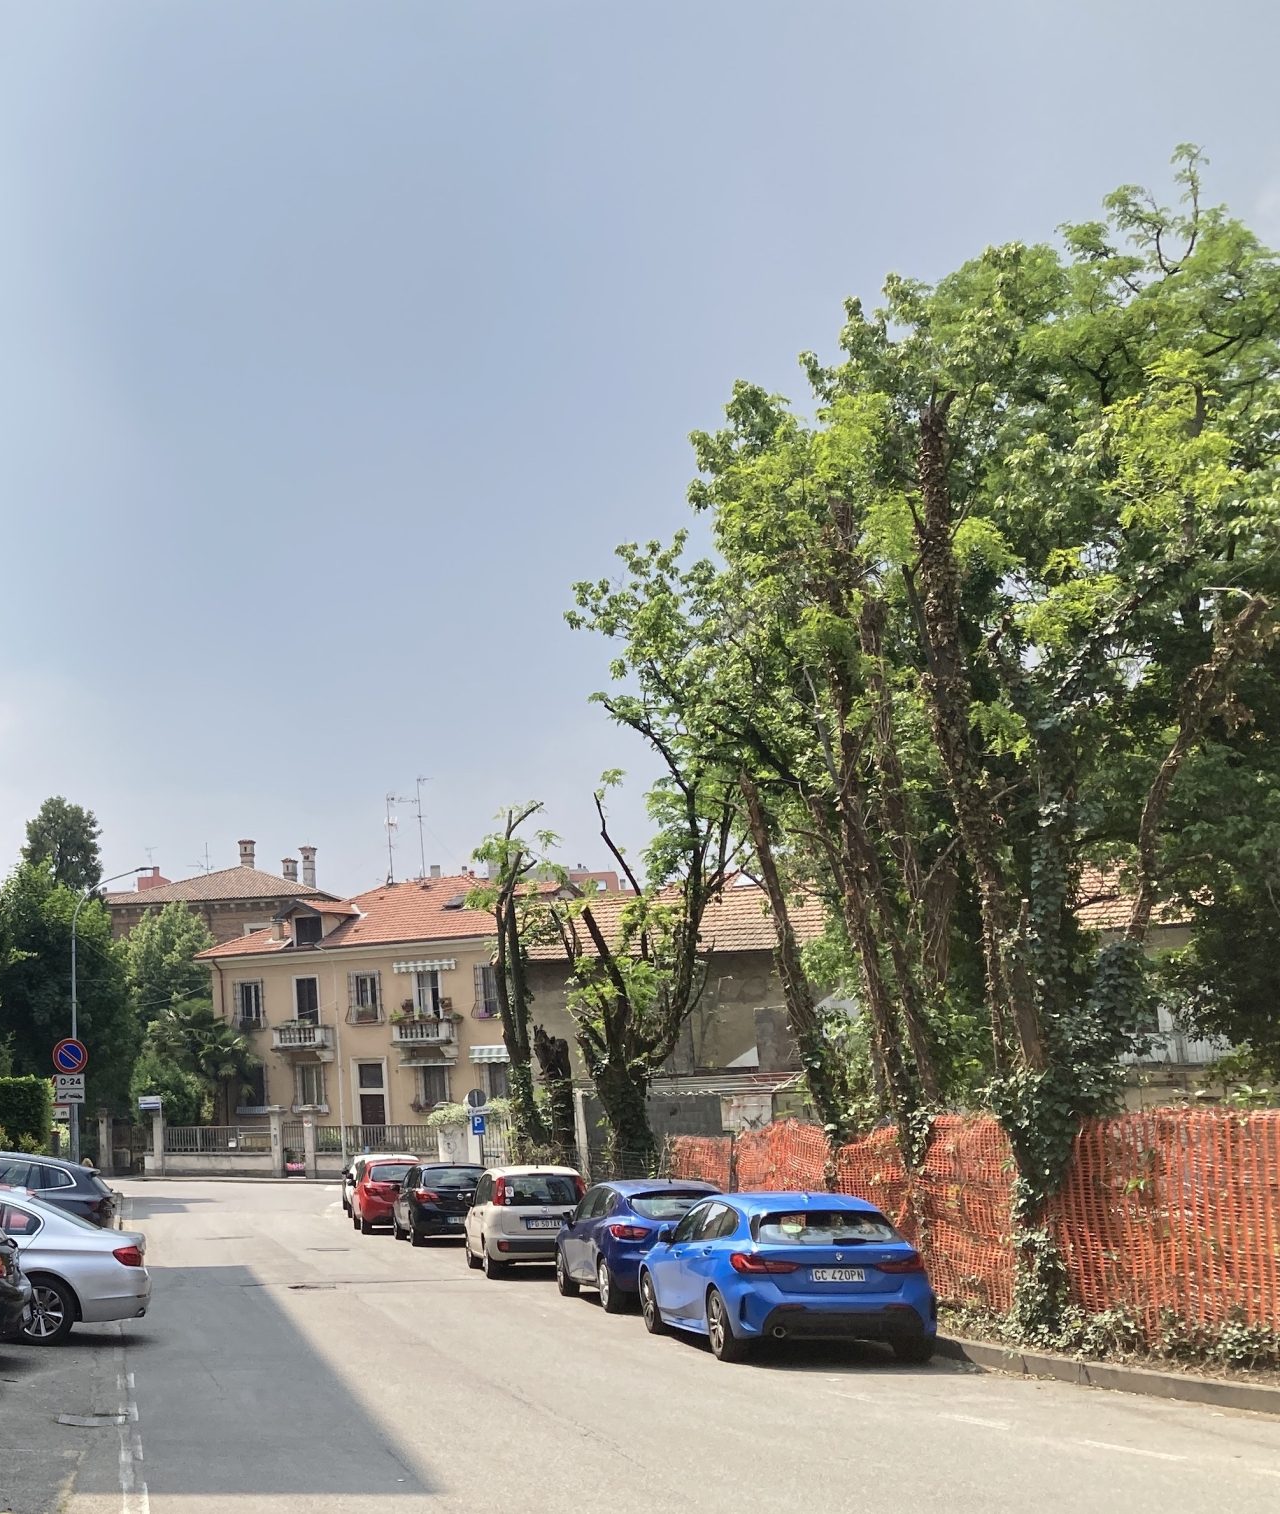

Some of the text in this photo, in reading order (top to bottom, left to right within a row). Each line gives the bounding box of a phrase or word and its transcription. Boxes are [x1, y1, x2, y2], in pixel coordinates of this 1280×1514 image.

[60, 1078, 81, 1086] 0-24
[474, 1116, 482, 1127] P
[831, 1270, 864, 1280] 420PN
